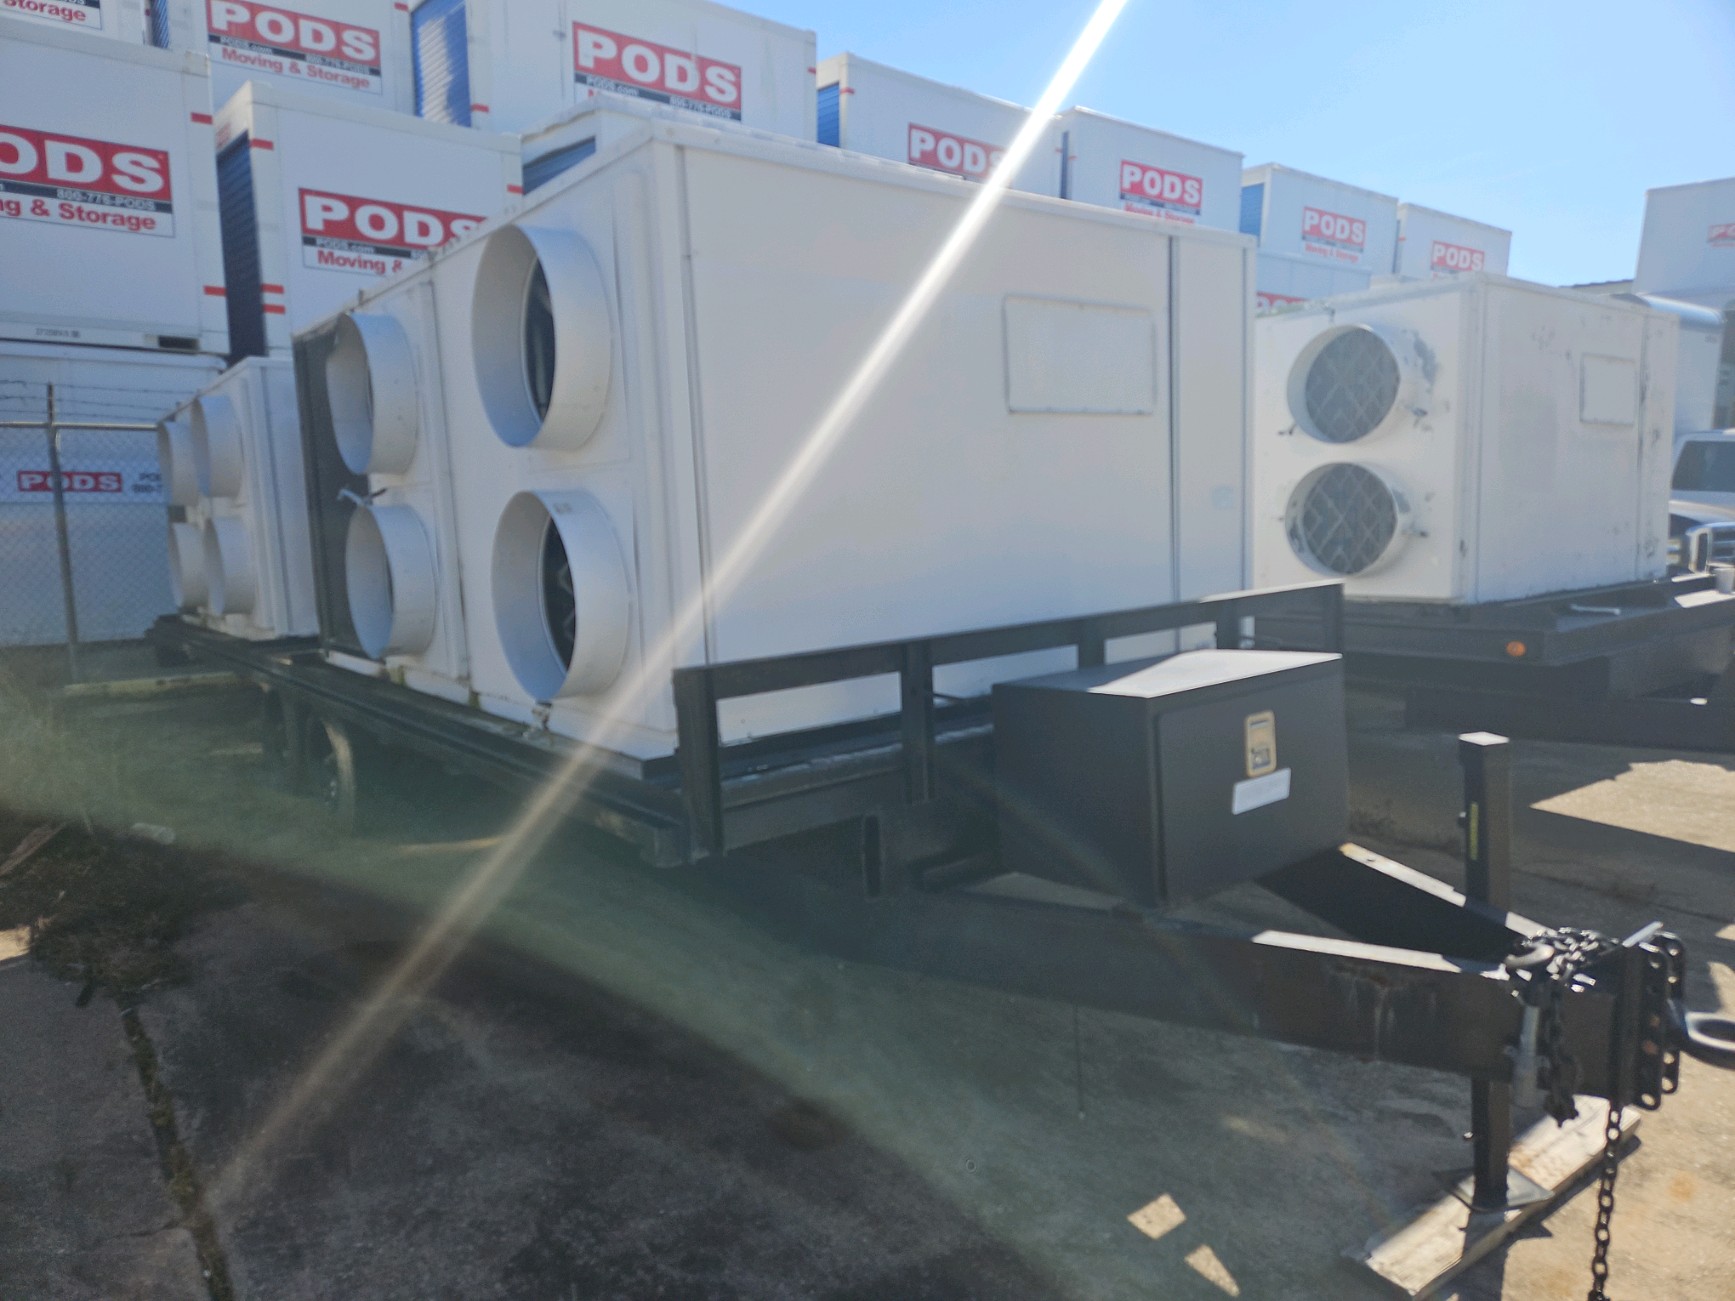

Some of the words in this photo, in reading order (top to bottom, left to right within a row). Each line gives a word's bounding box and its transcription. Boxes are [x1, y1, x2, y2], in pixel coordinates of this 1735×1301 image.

[210, 0, 376, 62] PODS
[222, 47, 284, 74] Moving
[289, 62, 301, 74] &
[307, 65, 370, 89] Storage
[577, 28, 738, 103] PODS
[1121, 164, 1200, 204] PODS
[31, 199, 50, 217] &
[59, 202, 157, 232] Storage
[1303, 209, 1364, 243] PODS
[317, 250, 386, 275] Moving
[1433, 244, 1483, 271] PODS
[21, 474, 119, 490] PODS
